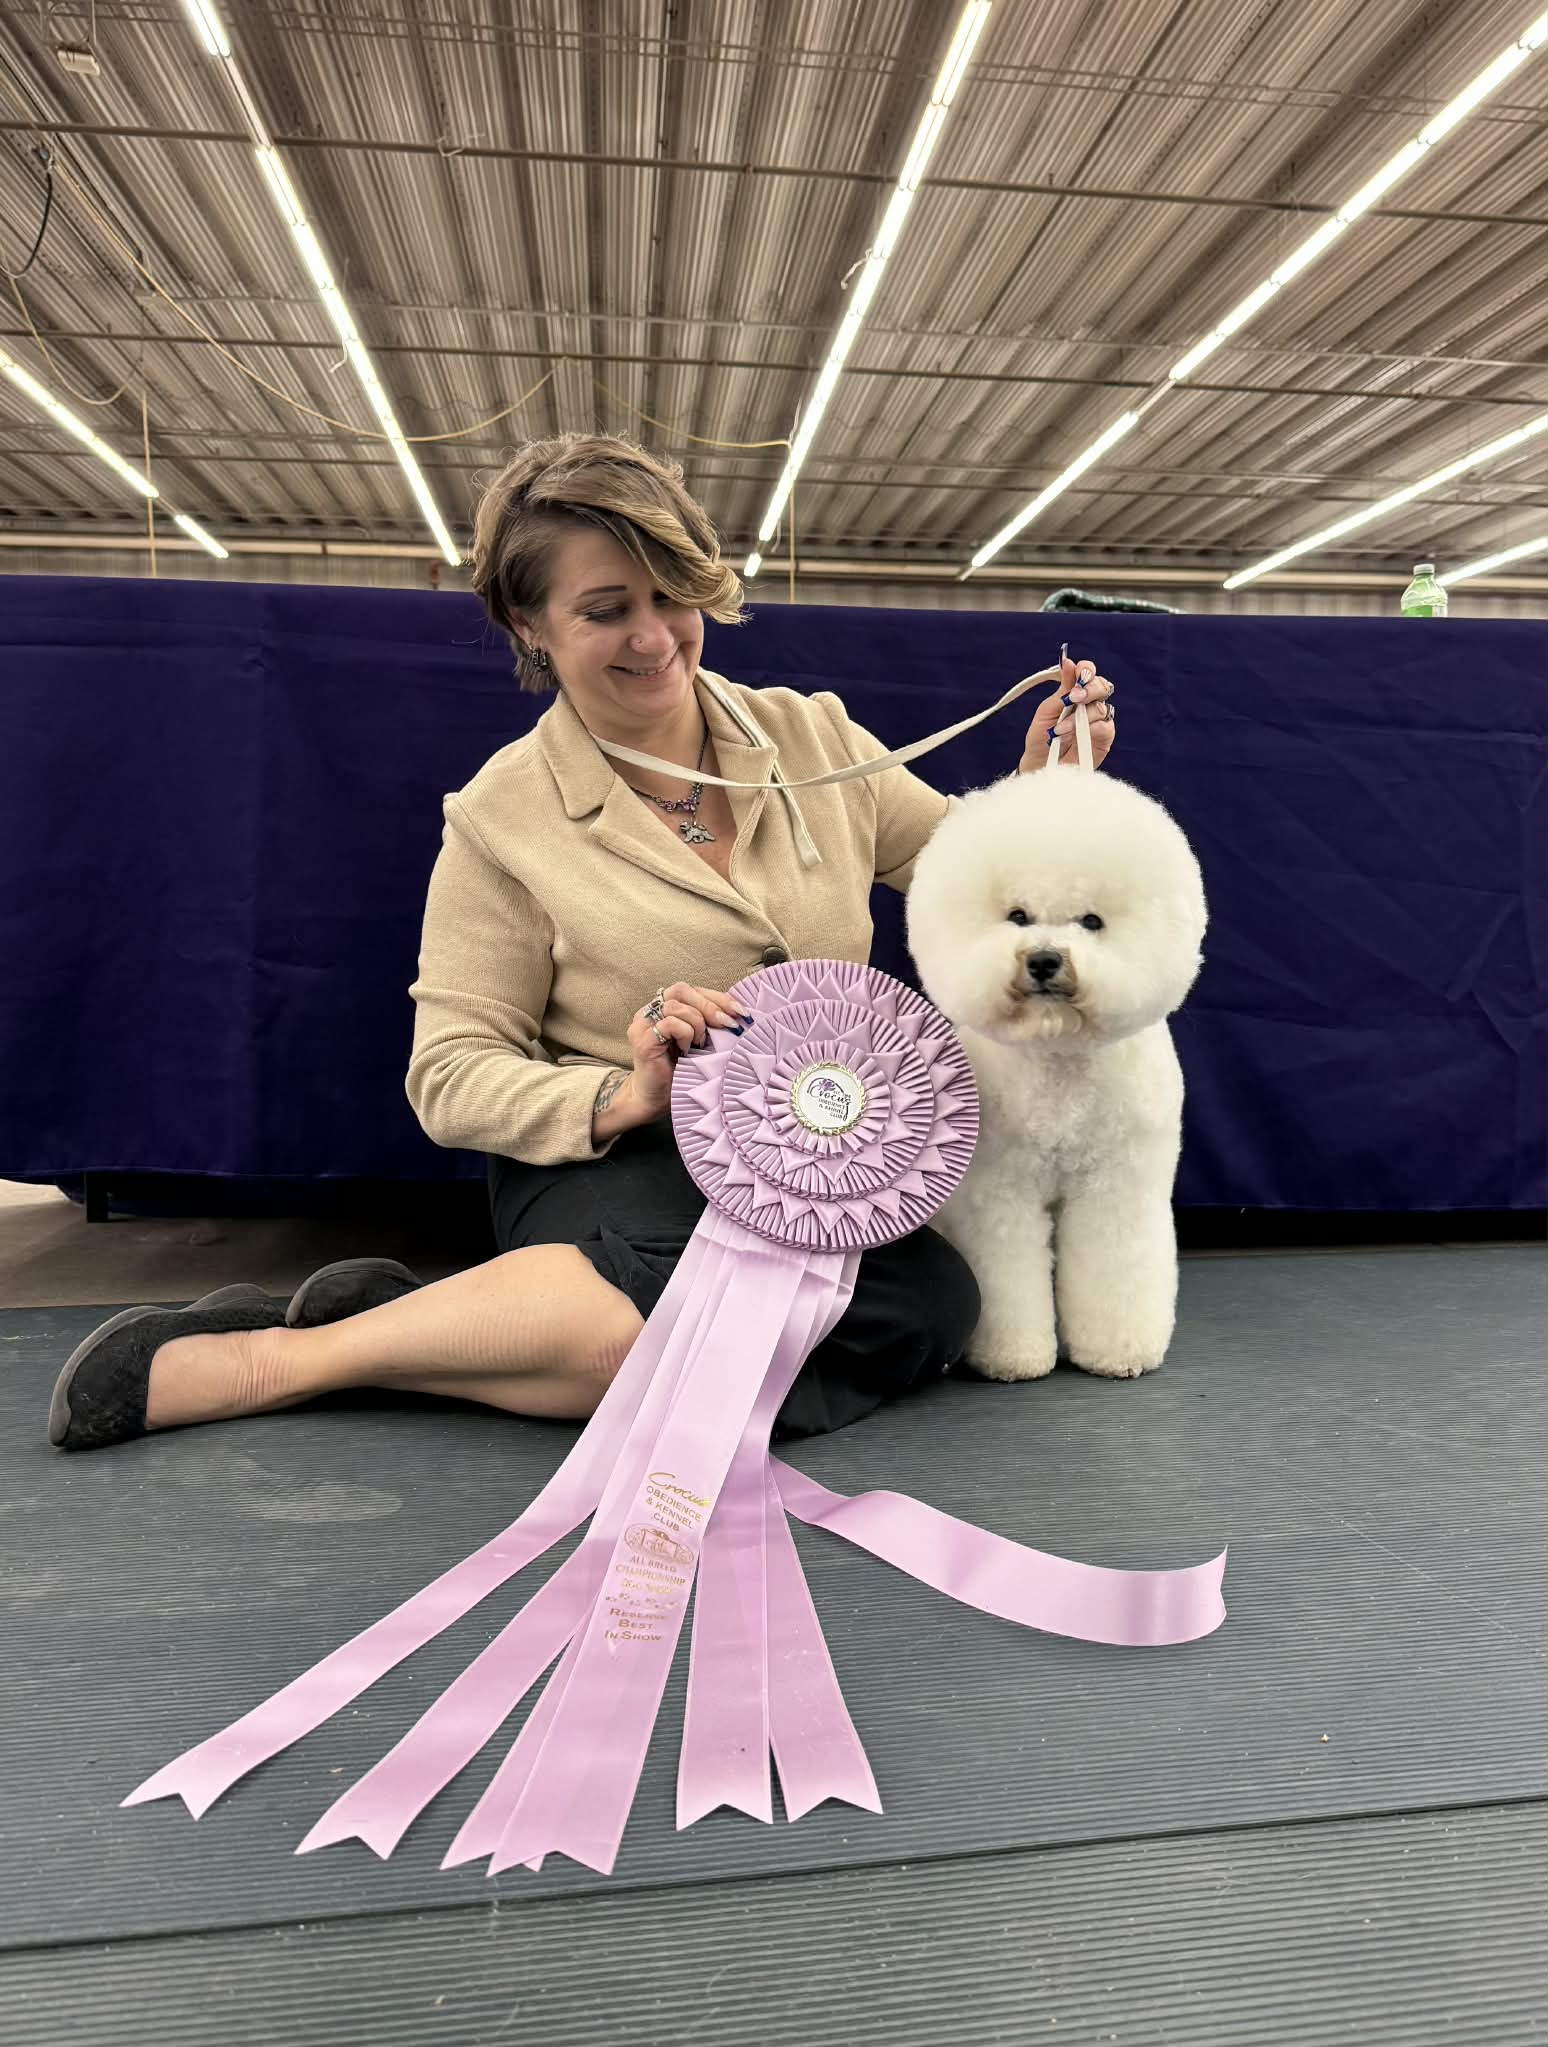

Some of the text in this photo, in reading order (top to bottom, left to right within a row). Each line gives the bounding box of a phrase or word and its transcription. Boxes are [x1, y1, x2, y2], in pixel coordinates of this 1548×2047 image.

[646, 1486, 704, 1522] OBEDIENCE
[646, 1497, 694, 1529] & KENNEL
[653, 1512, 680, 1531] CLUB
[618, 1619, 654, 1629] BEST
[604, 1629, 662, 1641] IN SHOW
